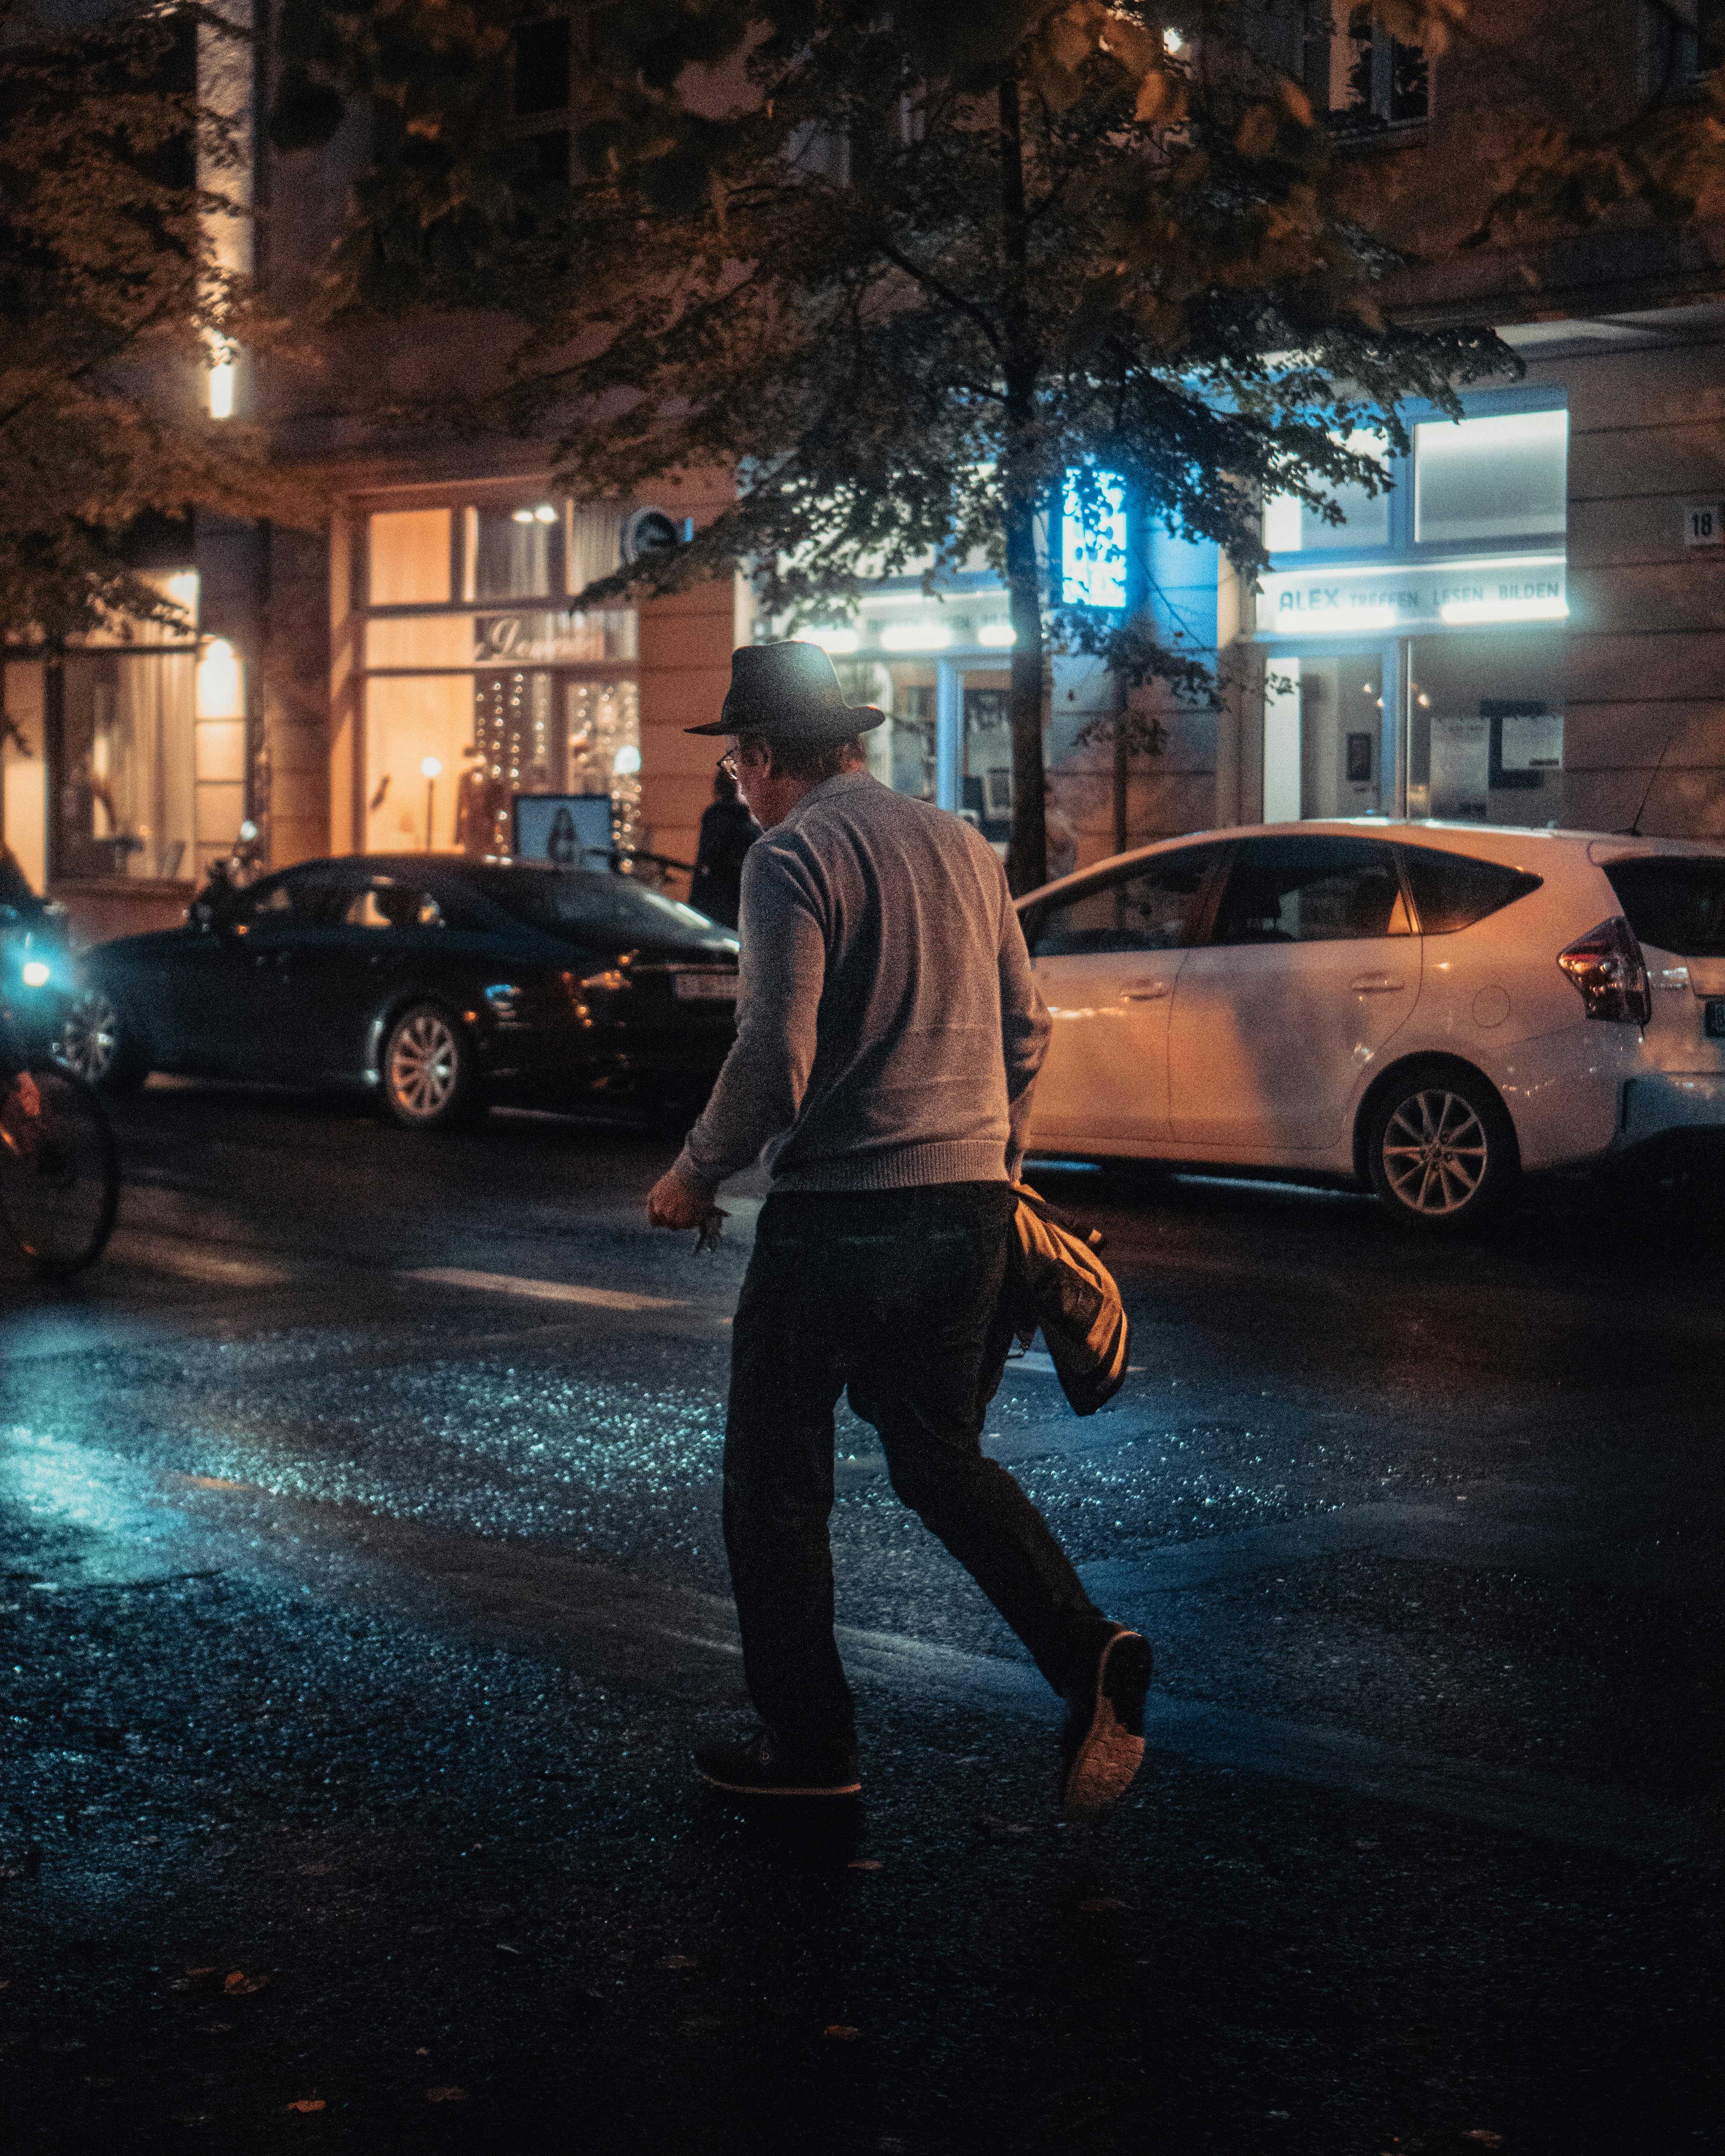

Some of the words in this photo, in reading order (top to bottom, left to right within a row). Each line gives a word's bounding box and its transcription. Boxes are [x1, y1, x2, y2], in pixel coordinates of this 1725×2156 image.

[1692, 512, 1712, 536] 18
[1279, 588, 1339, 611] ALEX
[1433, 586, 1484, 605] LESEN
[1498, 582, 1559, 600] BILDEN
